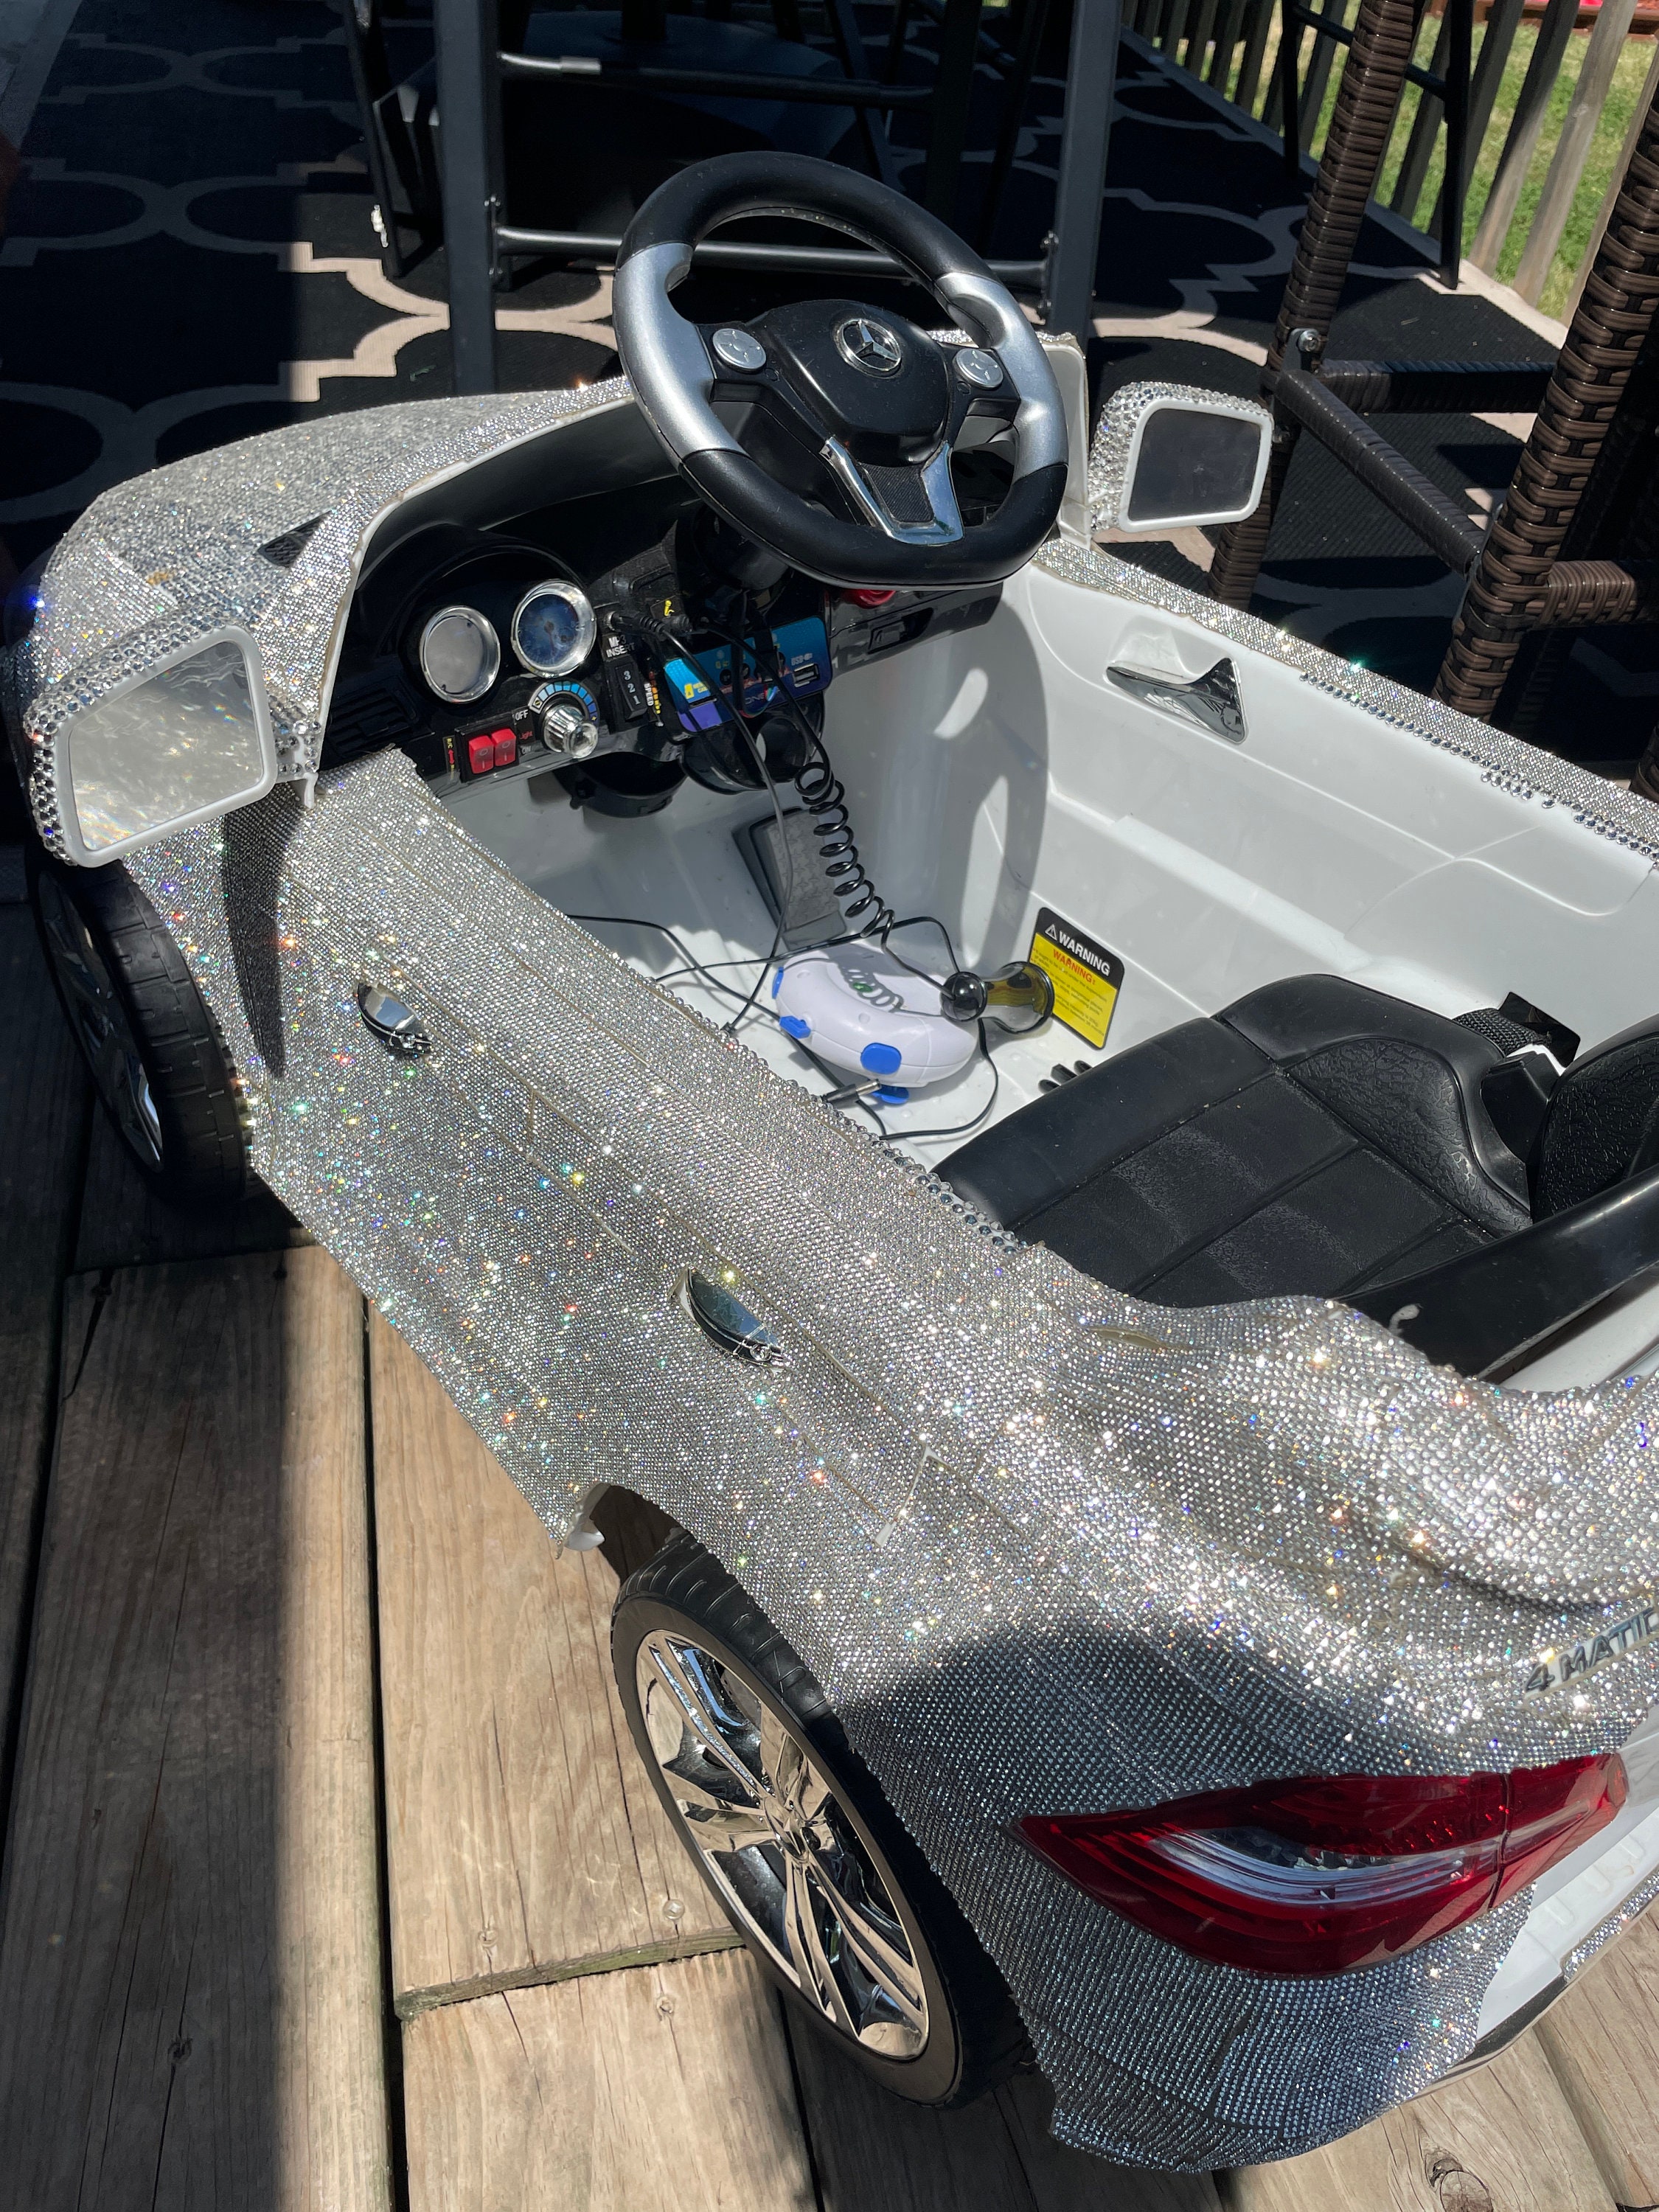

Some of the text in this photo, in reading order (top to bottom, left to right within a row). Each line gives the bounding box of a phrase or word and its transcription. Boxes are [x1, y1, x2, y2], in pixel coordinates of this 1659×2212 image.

[606, 642, 635, 658] INSERT
[623, 670, 631, 680] 3
[627, 683, 636, 693] 2
[643, 682, 654, 706] SPEED
[633, 695, 641, 705] 1
[515, 709, 529, 720] OFF
[521, 745, 532, 755] ON
[1059, 931, 1110, 976] WARNING
[1053, 949, 1096, 985] WARNING:
